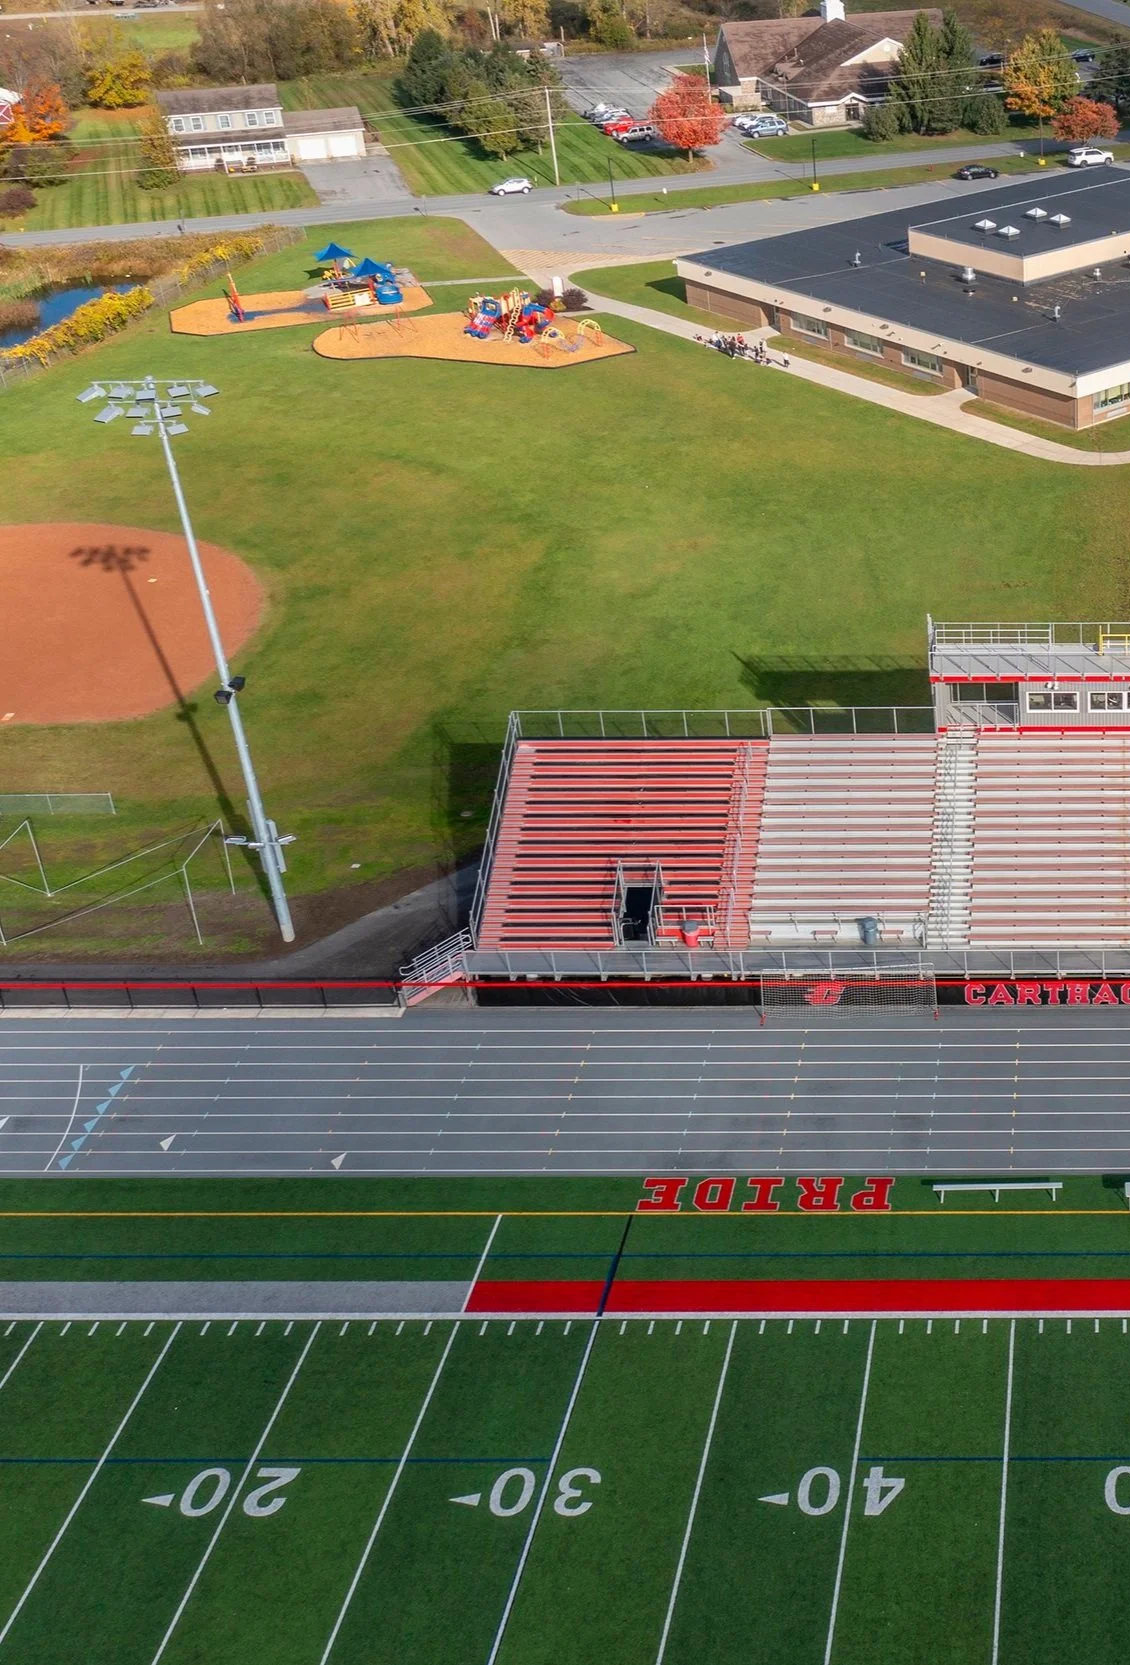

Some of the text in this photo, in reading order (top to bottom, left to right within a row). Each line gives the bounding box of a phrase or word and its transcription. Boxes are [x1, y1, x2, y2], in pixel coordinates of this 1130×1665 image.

[636, 1177, 895, 1211] PRIDE
[178, 1467, 302, 1517] 20
[488, 1467, 602, 1517] 30
[797, 1466, 906, 1516] 40
